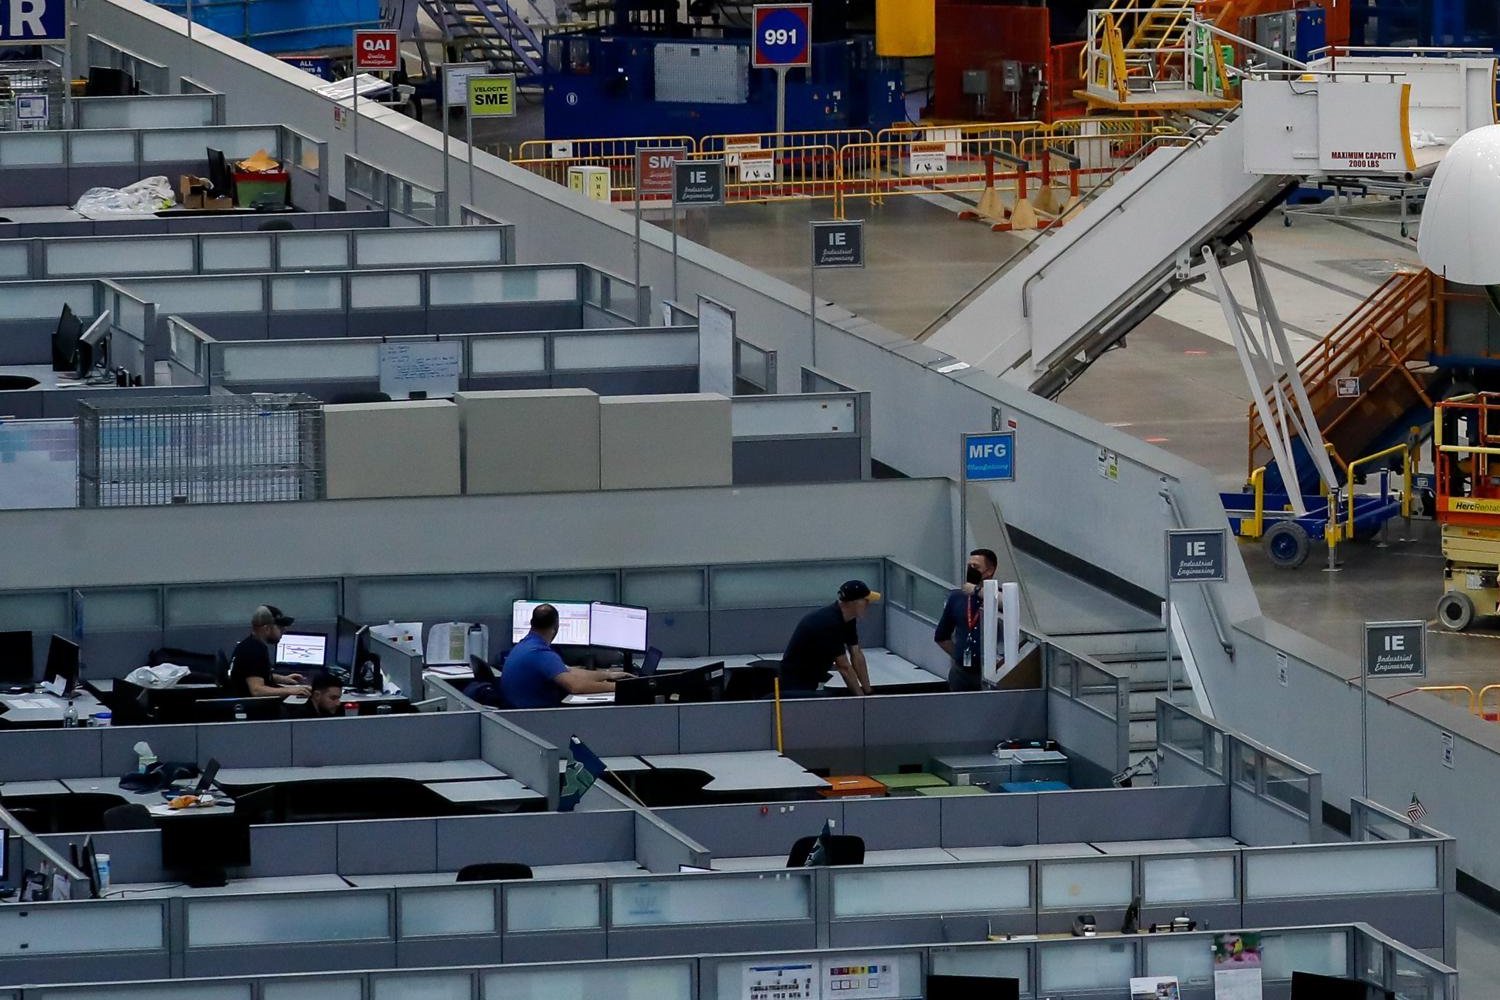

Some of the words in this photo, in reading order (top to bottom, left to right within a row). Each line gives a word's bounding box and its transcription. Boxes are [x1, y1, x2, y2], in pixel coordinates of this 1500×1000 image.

[765, 29, 797, 45] 991
[363, 39, 391, 51] QAI
[474, 94, 509, 106] SME
[1331, 151, 1364, 160] MAXIMUM
[1365, 151, 1397, 160] CAPACITY
[1348, 159, 1367, 168] 2000
[1367, 159, 1380, 168] LBS
[690, 171, 707, 184] IE
[829, 232, 846, 245] IE
[969, 443, 1007, 459] MFG
[1186, 541, 1206, 556] IE
[1179, 559, 1213, 567] Industrial
[1177, 567, 1215, 576] Engineering
[1384, 635, 1405, 650] IE
[1377, 654, 1413, 663] Industrial
[1375, 662, 1414, 672] Engineering
